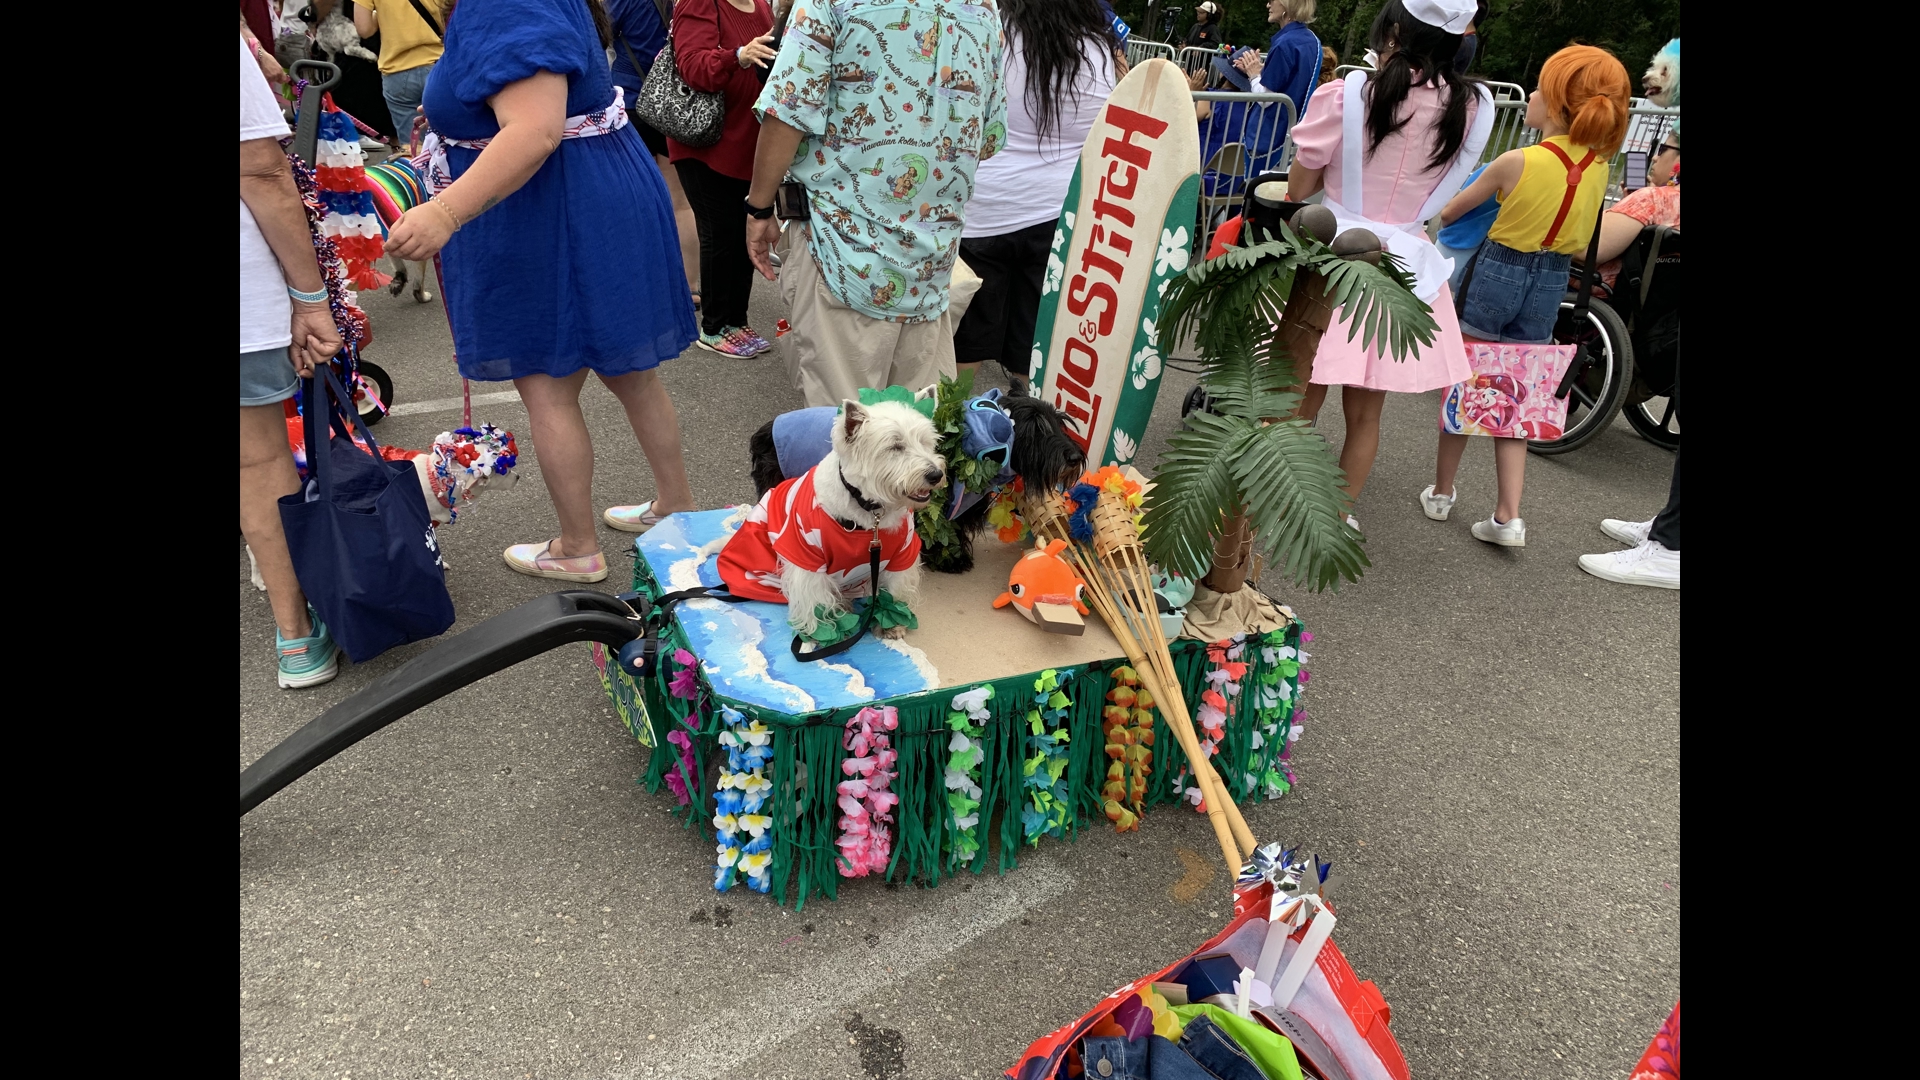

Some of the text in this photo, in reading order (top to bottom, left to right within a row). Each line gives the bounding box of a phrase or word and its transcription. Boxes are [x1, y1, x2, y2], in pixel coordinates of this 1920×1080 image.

[955, 20, 979, 48] Hawaiian
[847, 15, 920, 88] Hawaiian Roller Coaster Ride
[781, 65, 795, 79] Ride
[861, 138, 897, 154] Hawaiian
[897, 136, 918, 147] Roller
[849, 173, 861, 194] Roller
[855, 194, 876, 218] Coaster
[876, 215, 893, 226] Ride
[821, 227, 842, 262] Hawaiian
[837, 263, 847, 286] Roller
[1079, 319, 1097, 343] &
